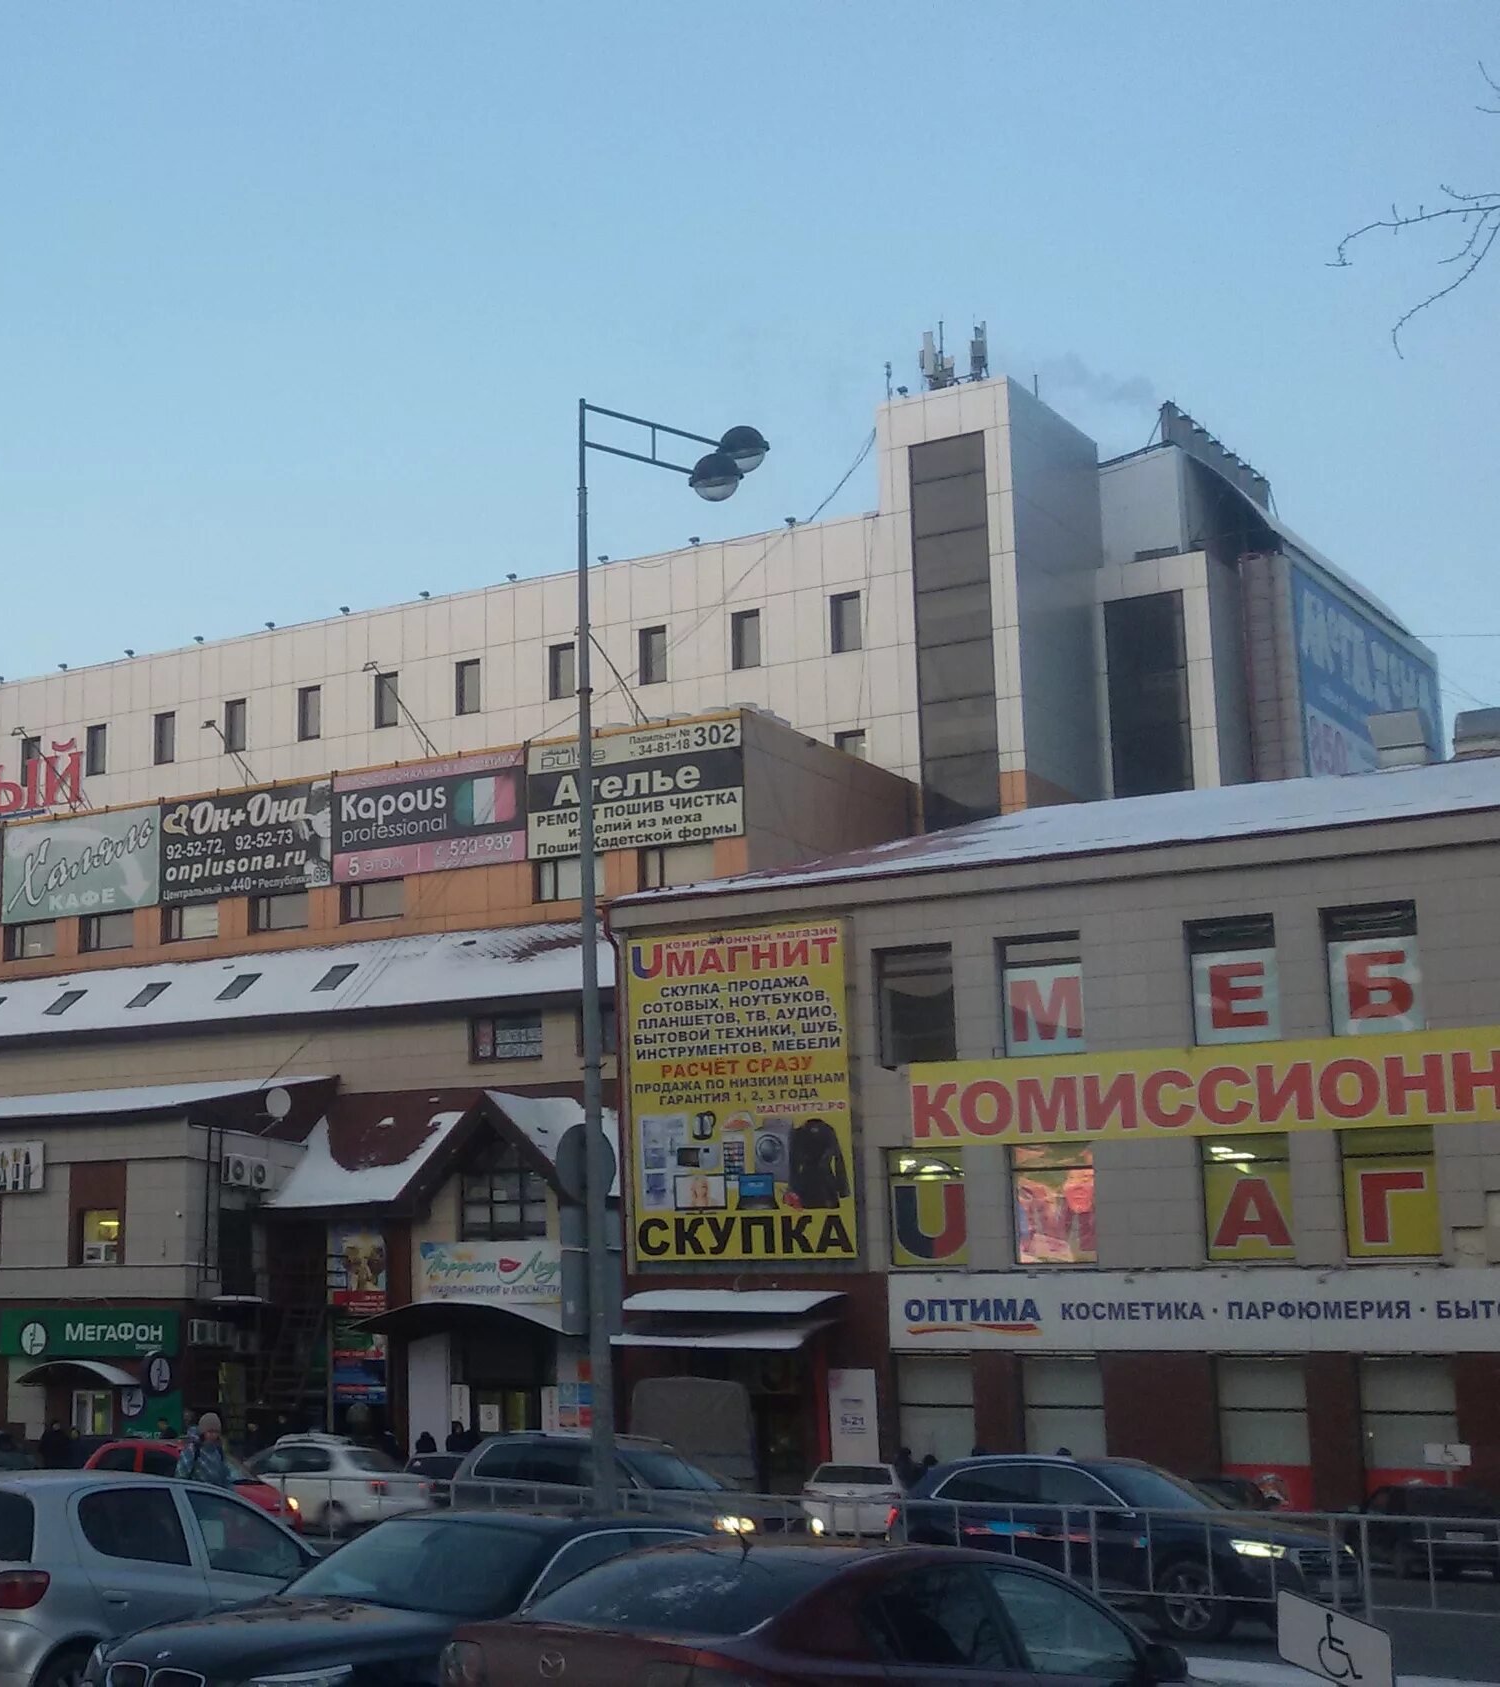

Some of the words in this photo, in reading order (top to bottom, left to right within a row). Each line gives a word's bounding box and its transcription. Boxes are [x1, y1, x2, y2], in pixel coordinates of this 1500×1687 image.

[639, 739, 690, 756] 34-81-18
[693, 724, 736, 747] 302
[540, 747, 606, 770] pule
[341, 786, 447, 824] Kapous
[537, 809, 598, 827] РЕМОТ
[604, 800, 664, 818] ПОШИВ
[670, 791, 737, 810] ЧИСТКА
[342, 813, 447, 846] professional
[568, 818, 631, 837] изелий
[637, 818, 656, 829] из
[662, 812, 702, 826] меха
[166, 839, 226, 860] 92-52-72,
[235, 829, 294, 850] 92-52-73
[537, 839, 581, 855] Поши
[678, 824, 737, 840] формы
[7, 818, 155, 915] Халяль
[165, 850, 307, 883] onplusona.ru
[348, 856, 360, 877] 5
[363, 857, 405, 873] этаж
[48, 887, 116, 912] КАФЕ
[163, 883, 222, 901] Центральный
[258, 873, 311, 889] Республики
[642, 998, 725, 1015] СОТОВЫХ,
[729, 990, 831, 1007] НОУТБУКОВ,
[637, 1011, 741, 1030] ПЛАНШЕТОВ,
[745, 1009, 771, 1022] ТВ,
[776, 1005, 837, 1020] АУДИО,
[633, 1027, 710, 1046] БЫТОВОЙ
[715, 1023, 797, 1040] ТЕХНИКИ,
[802, 1020, 843, 1035] ШУБ,
[636, 1040, 767, 1060] ИНСТРУМЕНТОВ,
[772, 1036, 841, 1052] МЕБЕЛИ
[661, 1058, 740, 1079] РАСЧЁТ
[746, 1055, 813, 1074] СРАЗУ
[634, 1079, 702, 1095] ПРОДАЖА
[705, 1078, 725, 1090] ПО
[729, 1075, 790, 1089] НИЗКИМ
[793, 1072, 845, 1087] ЦЕНАМ
[659, 1092, 730, 1107] ГАРАНТИЯ
[767, 1089, 776, 1099] 3
[780, 1088, 819, 1101] ГОДА
[638, 1215, 854, 1257] СКУПКА
[904, 1299, 1042, 1322] ОПТИМА
[1061, 1302, 1206, 1321] КОСМЕТИКА
[1227, 1300, 1411, 1320] ПАРФЮМЕРИЯ
[1436, 1300, 1500, 1319] БЫТ
